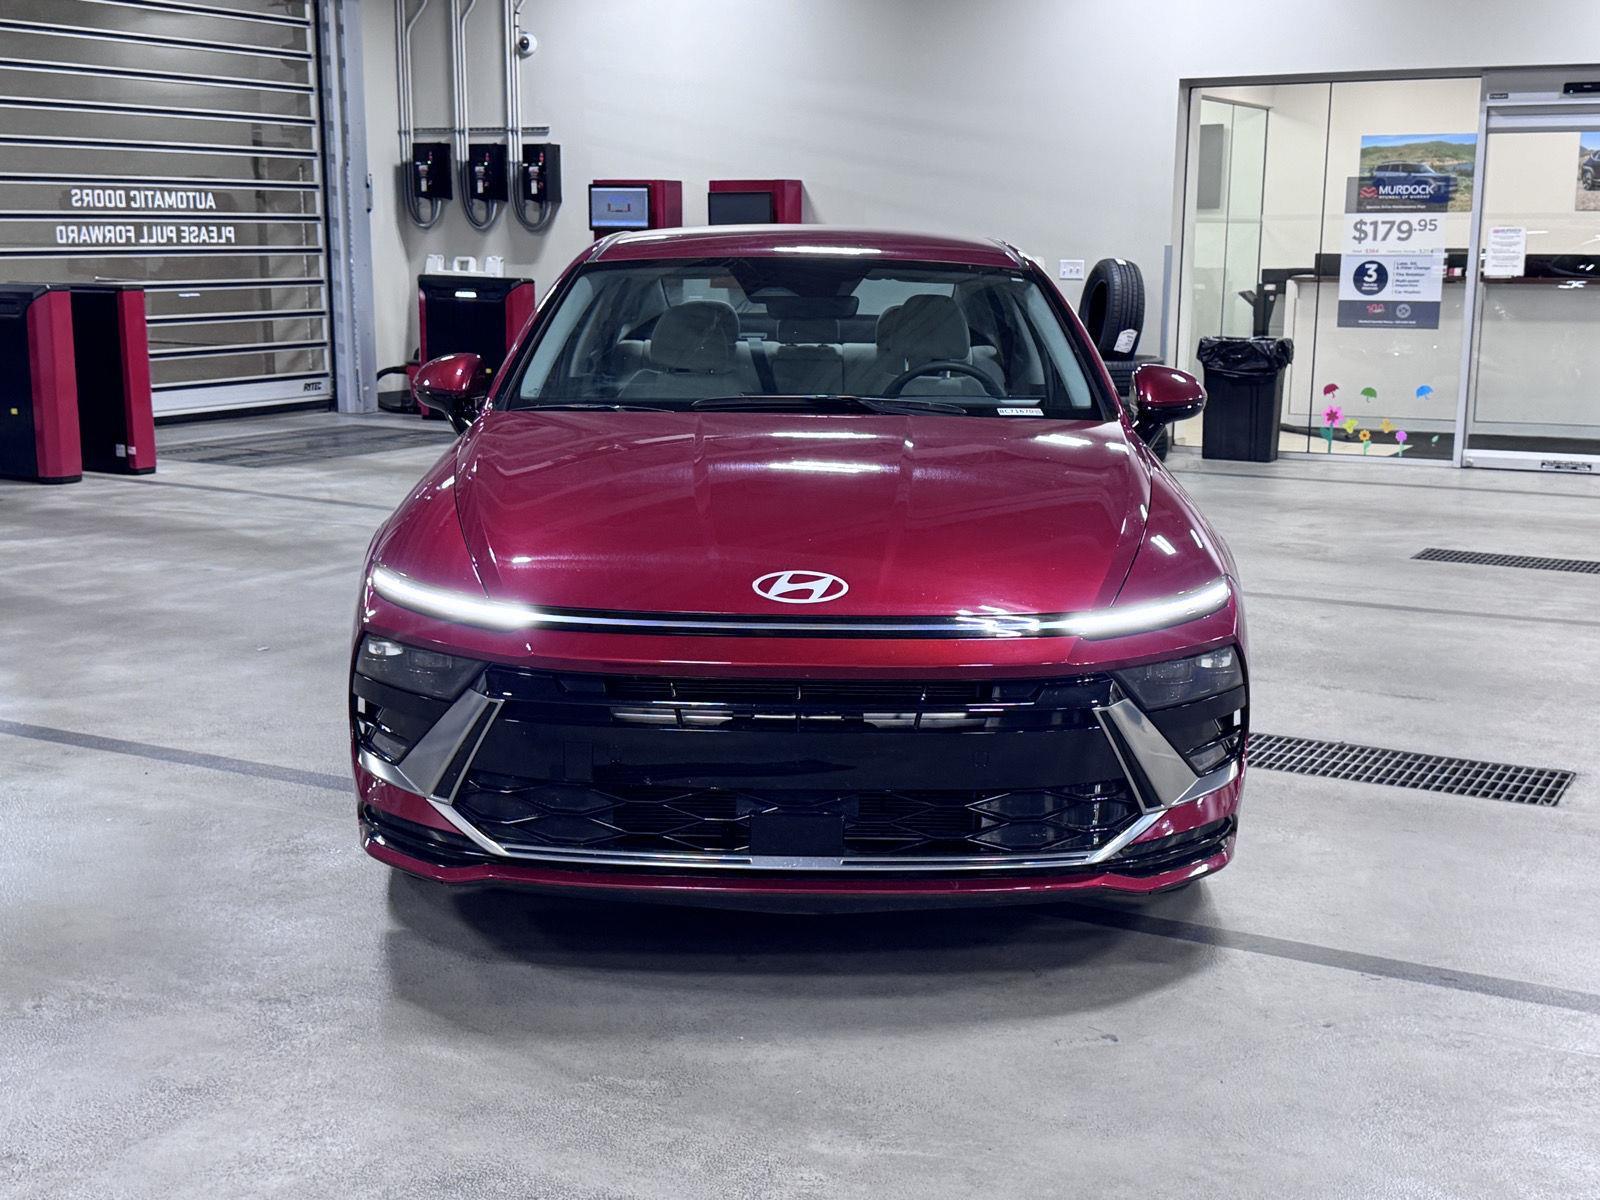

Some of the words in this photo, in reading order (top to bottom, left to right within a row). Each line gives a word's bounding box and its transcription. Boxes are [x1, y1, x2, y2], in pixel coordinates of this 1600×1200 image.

[1379, 185, 1434, 195] MURDOCK
[1352, 219, 1438, 244] $179.95
[1363, 263, 1378, 282] 3
